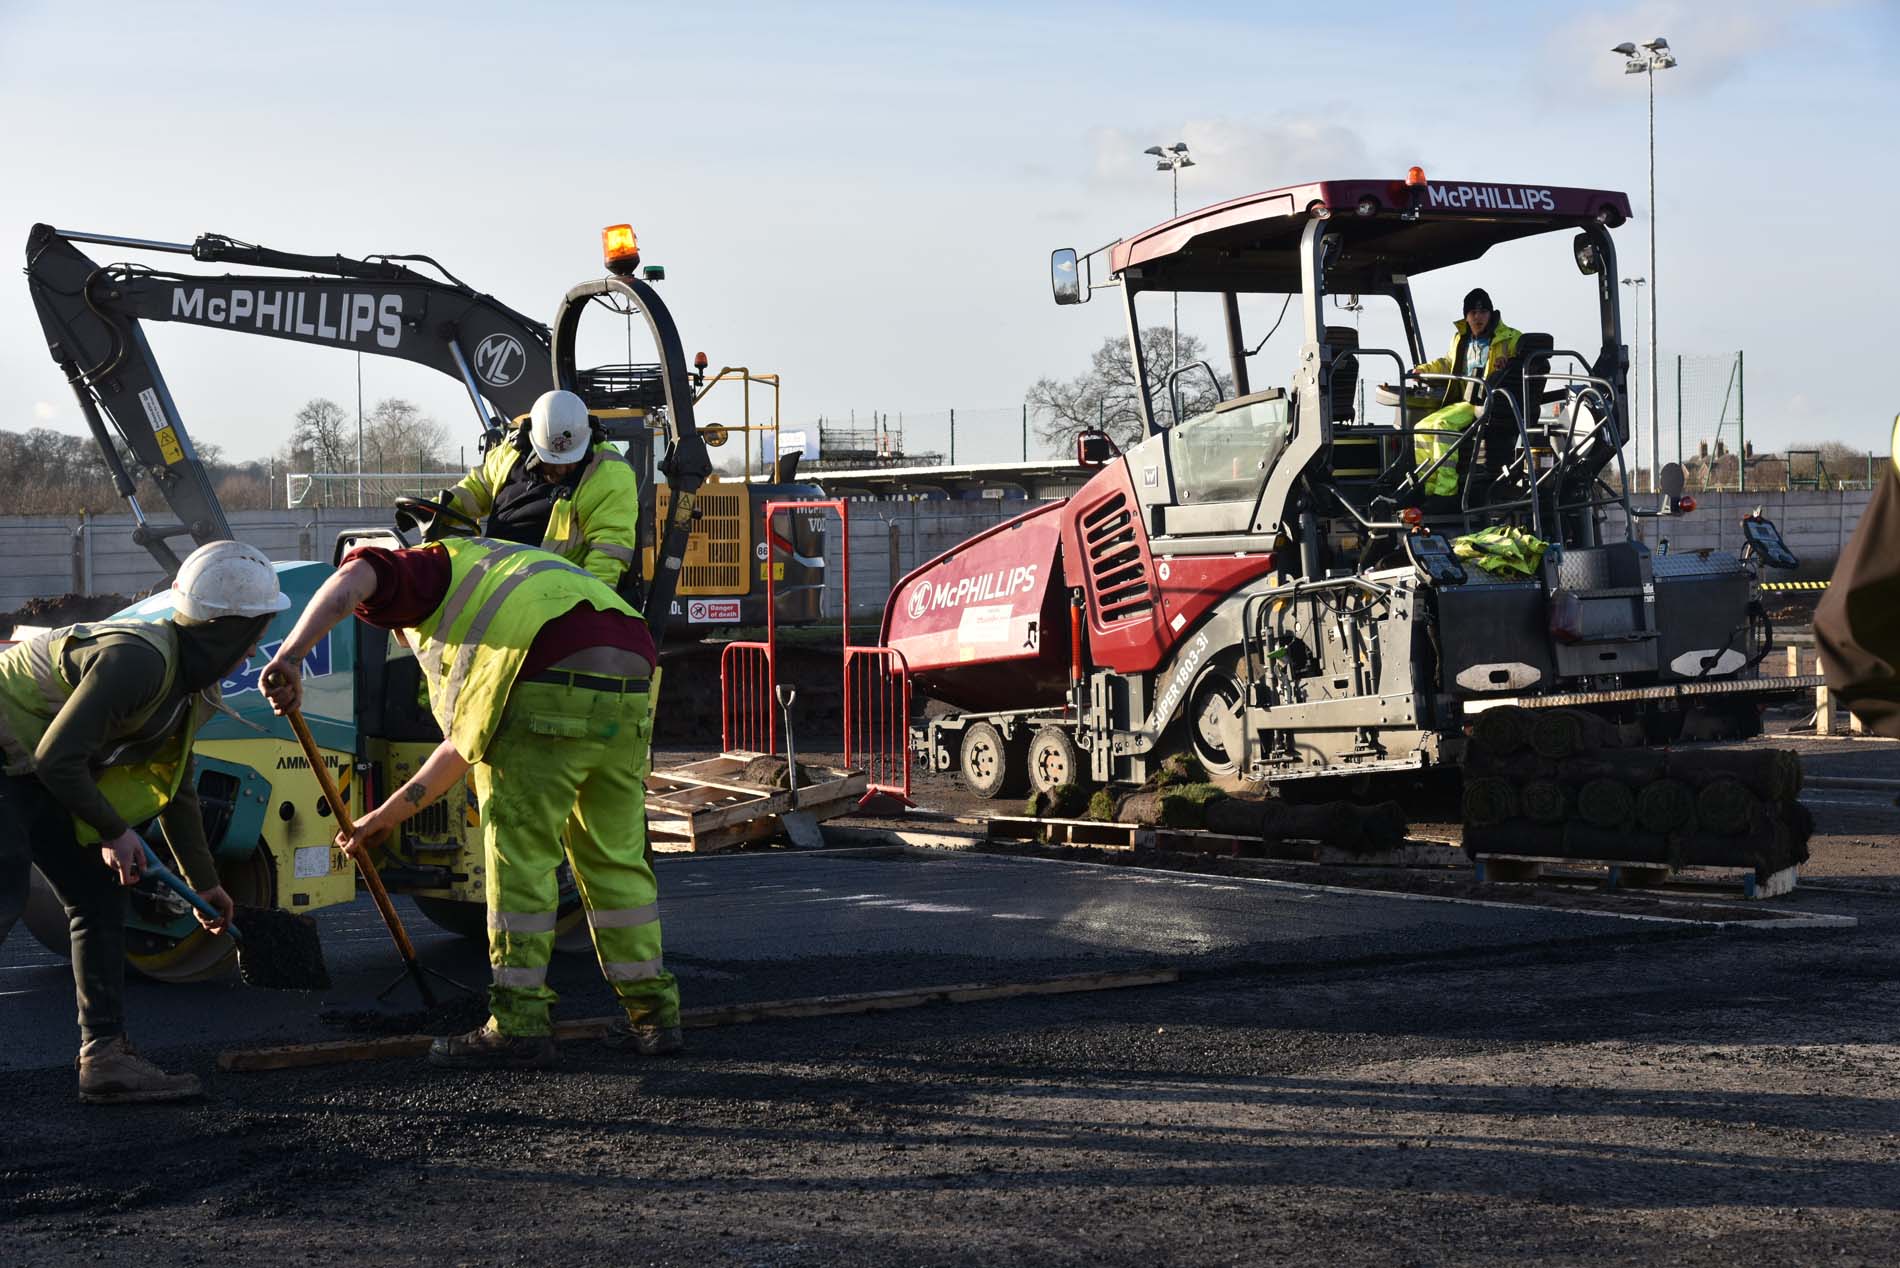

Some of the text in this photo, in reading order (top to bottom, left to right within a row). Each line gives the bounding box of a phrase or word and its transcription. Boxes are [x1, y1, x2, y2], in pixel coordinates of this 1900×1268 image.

[1427, 185, 1555, 210] McPHILLIPS
[171, 287, 403, 348] McPHILLIPS
[931, 564, 1037, 610] McPHILLIPS
[1152, 632, 1208, 730] SUPER 1803-3i
[276, 756, 338, 769] AMMNN
